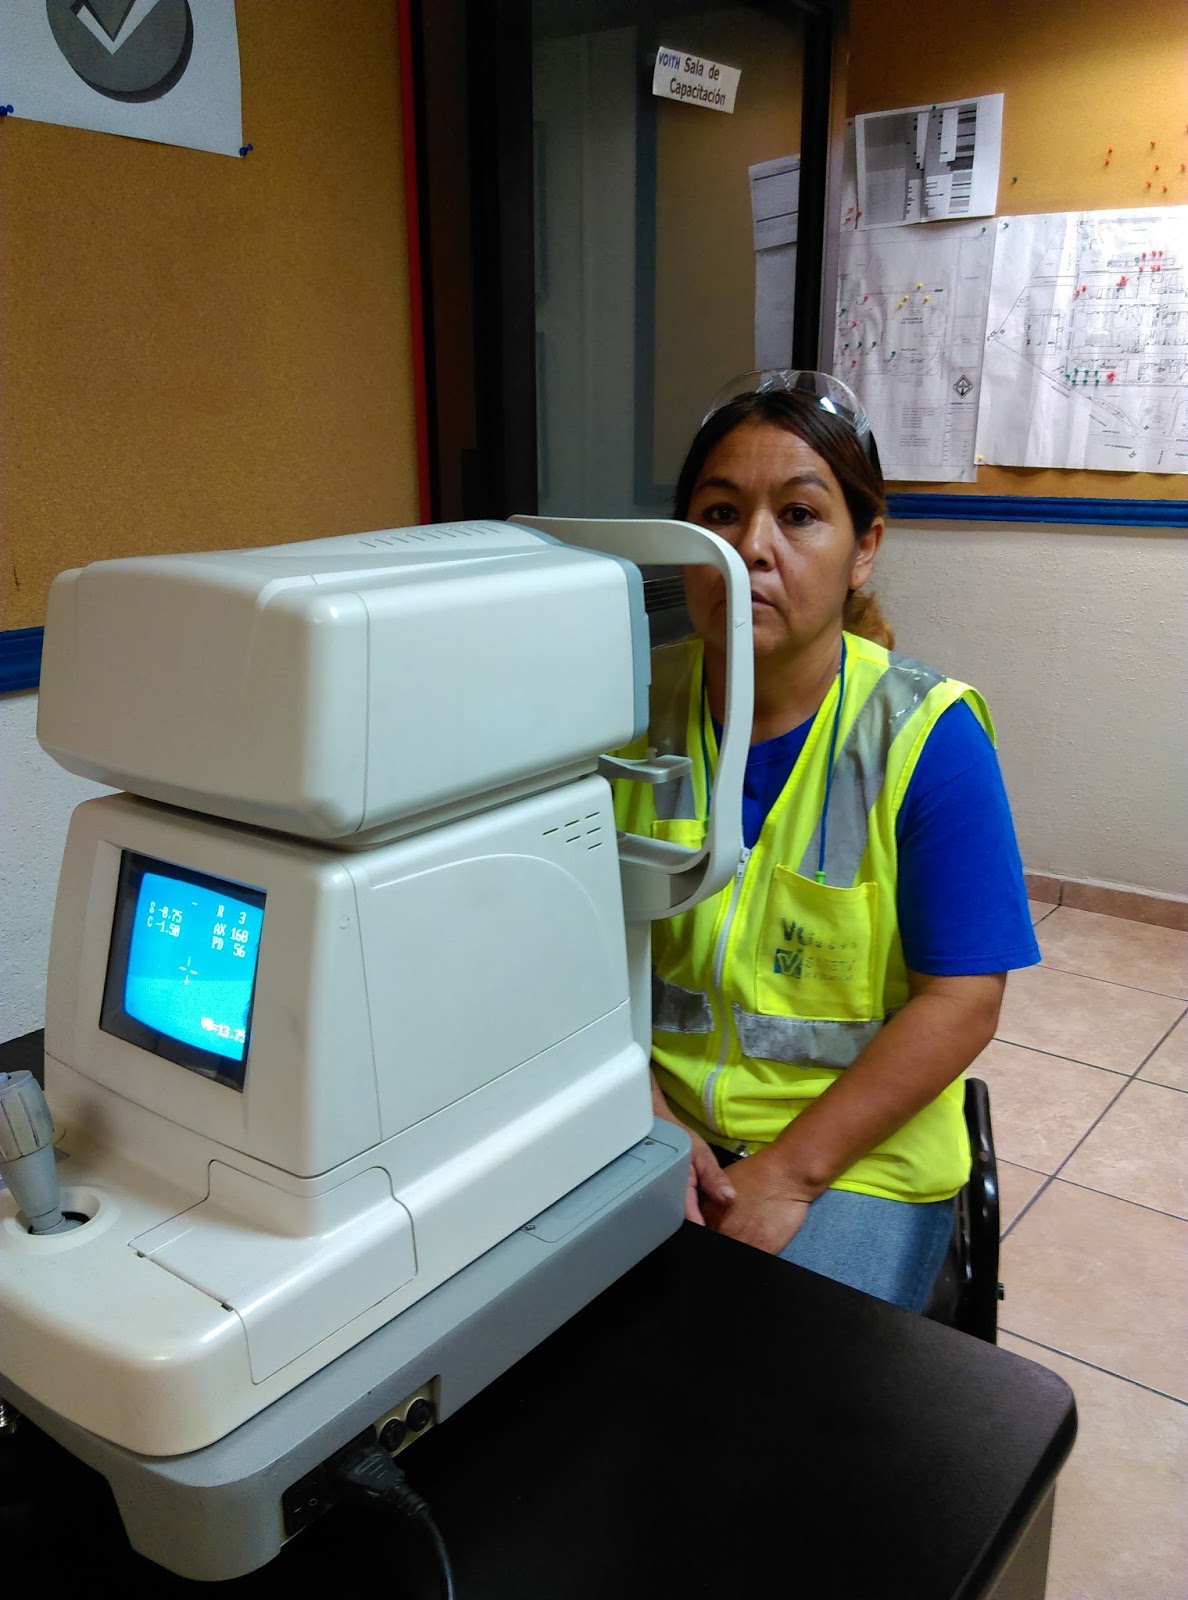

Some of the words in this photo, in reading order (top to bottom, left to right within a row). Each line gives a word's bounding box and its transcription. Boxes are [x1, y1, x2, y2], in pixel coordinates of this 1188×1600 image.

[659, 52, 681, 70] VOITH
[684, 57, 704, 76] Sala
[708, 64, 720, 80] de
[669, 77, 726, 106] Capacitación
[149, 901, 156, 914] S
[216, 904, 225, 919] R
[238, 911, 247, 925] 3
[147, 915, 153, 928] C
[213, 922, 227, 937] AX
[210, 936, 225, 951] PD
[232, 943, 246, 958] 56
